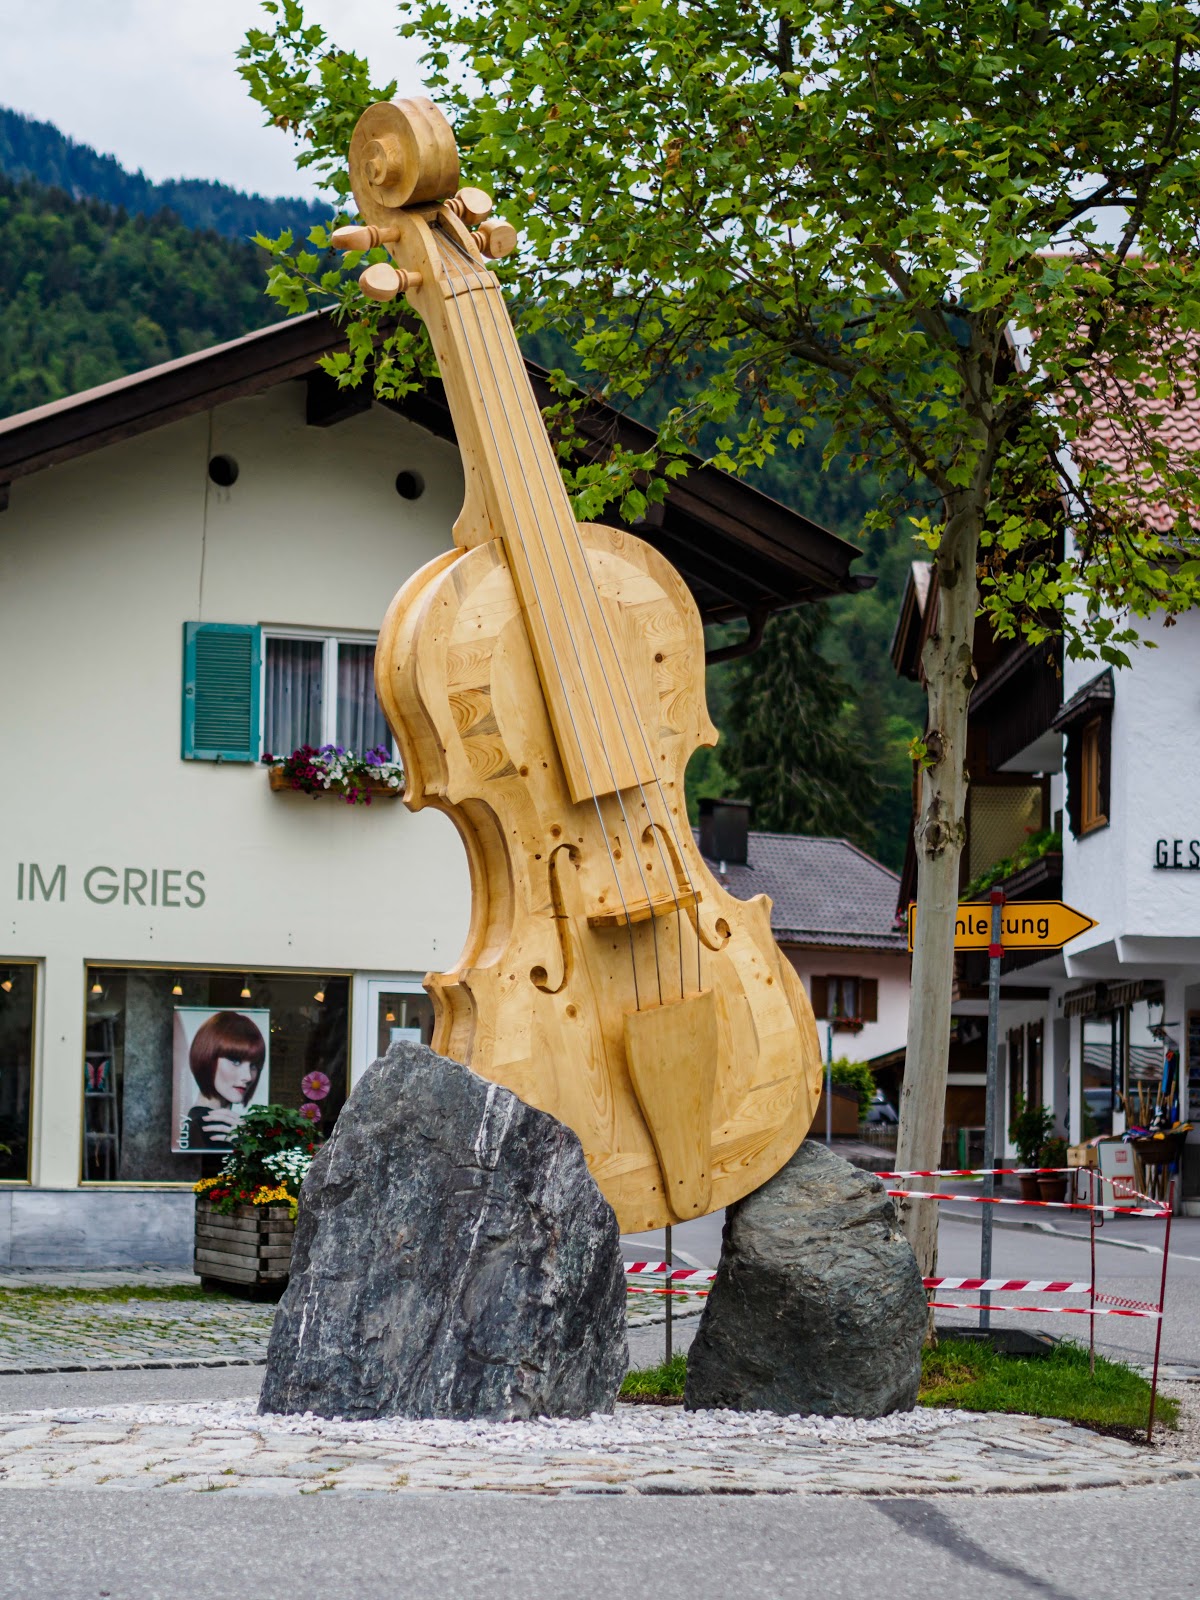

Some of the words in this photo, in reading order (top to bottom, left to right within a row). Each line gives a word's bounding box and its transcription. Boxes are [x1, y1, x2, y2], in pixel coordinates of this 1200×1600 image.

[17, 862, 66, 902] IM
[83, 866, 206, 908] GRIES
[176, 1113, 192, 1149] dusy
